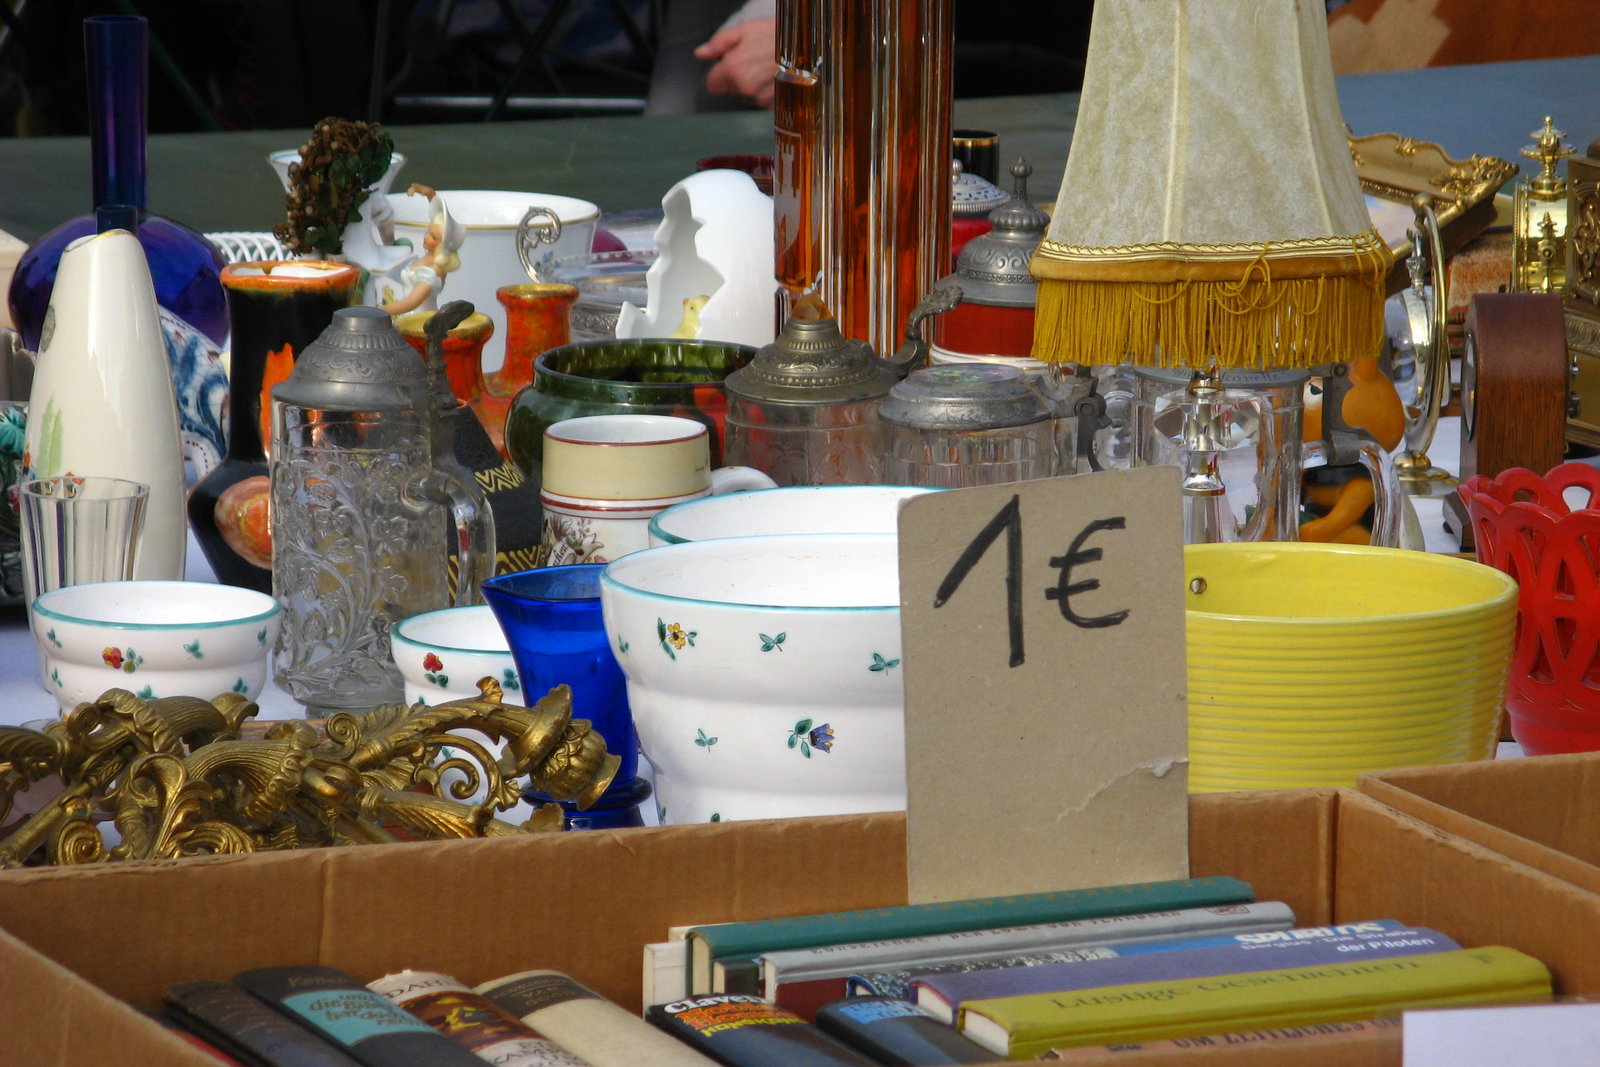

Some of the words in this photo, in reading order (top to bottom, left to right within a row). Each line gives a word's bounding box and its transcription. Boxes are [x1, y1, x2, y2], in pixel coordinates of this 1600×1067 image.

[932, 494, 1025, 668] 1
[1045, 517, 1131, 629] €
[1337, 943, 1367, 953] der
[1368, 938, 1437, 950] Piloten
[1051, 989, 1191, 1009] Lustige
[1197, 962, 1421, 992] Geschichten
[309, 999, 342, 1012] die
